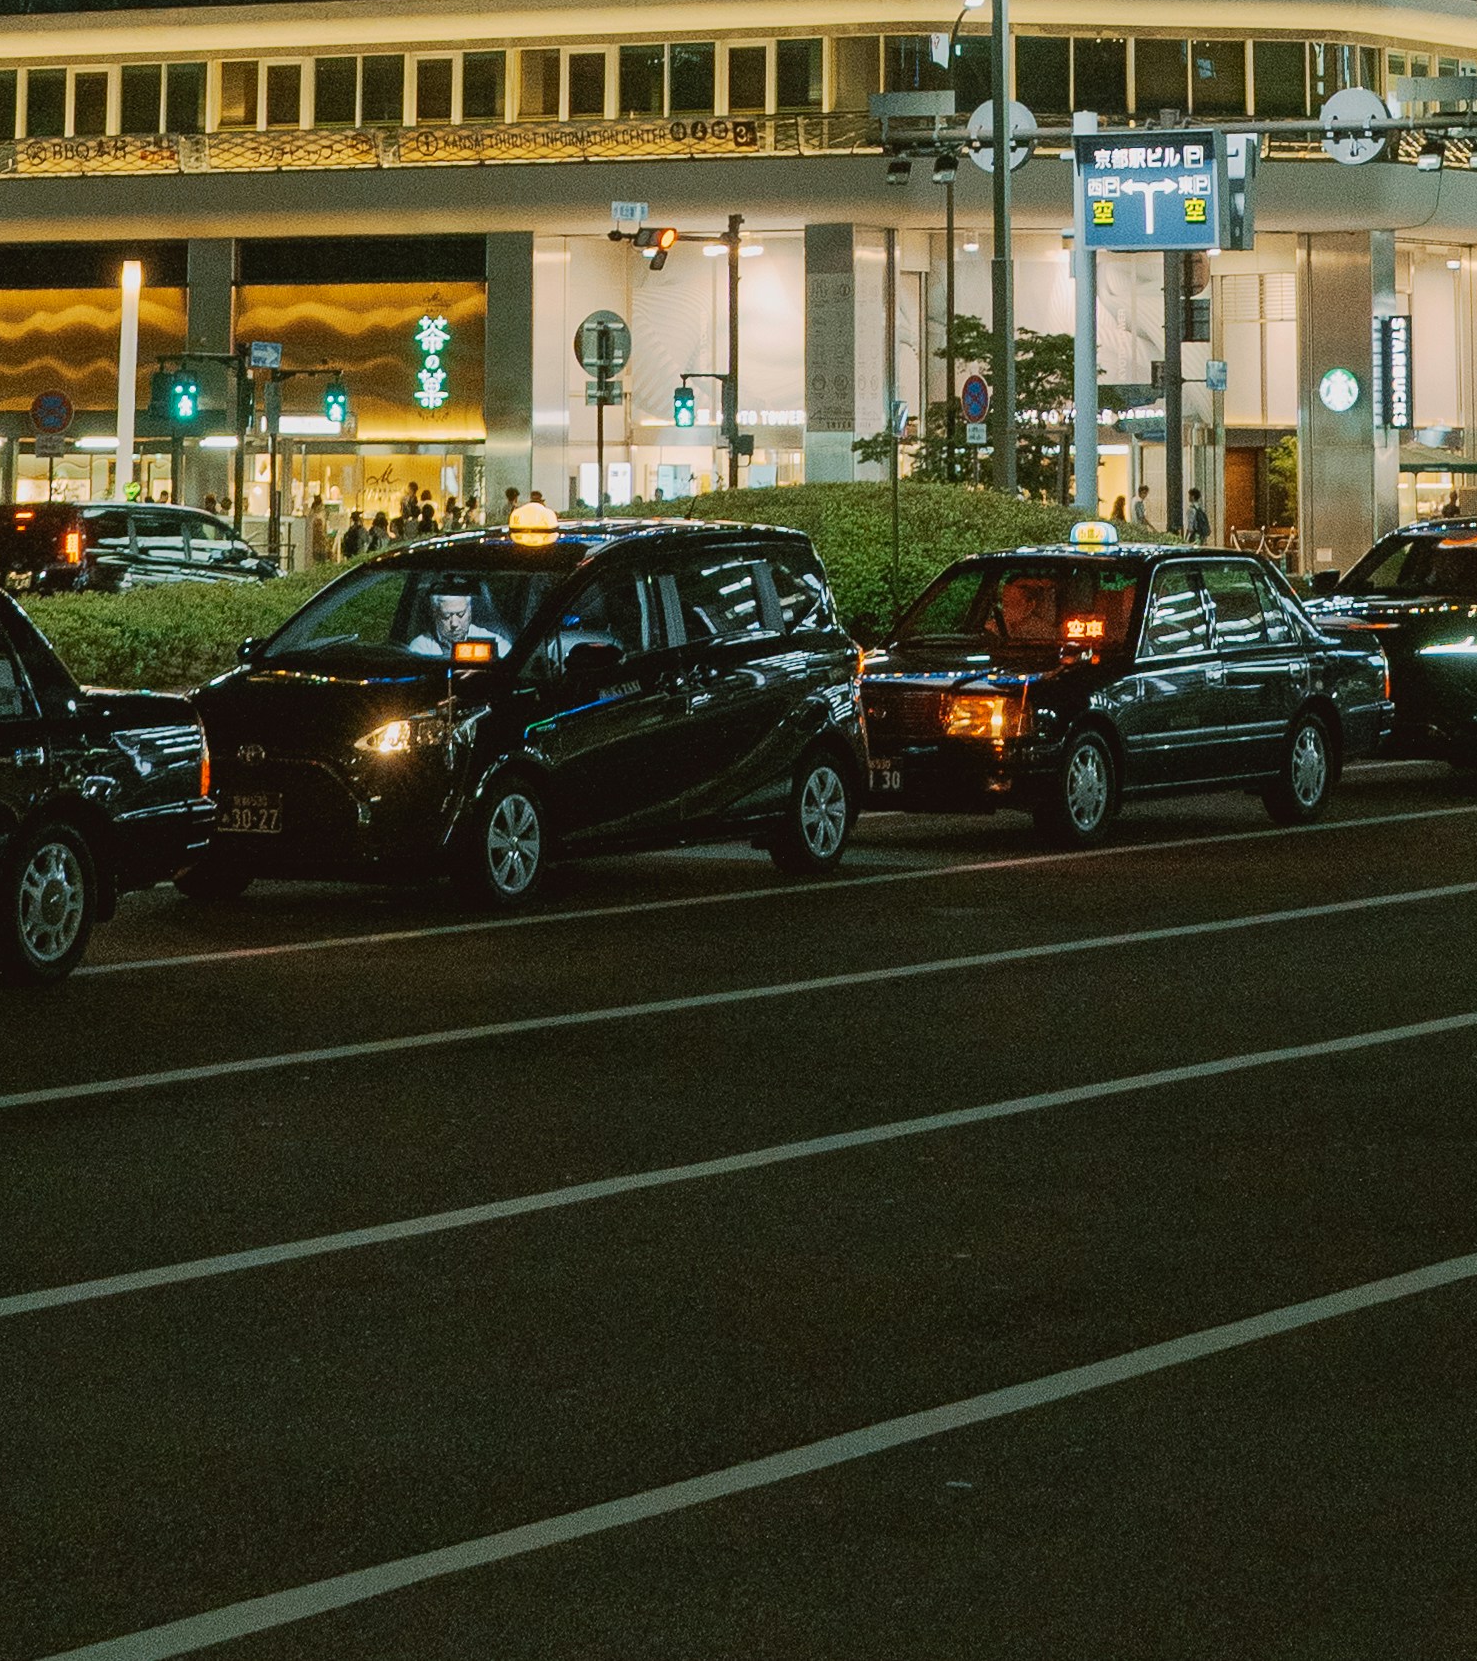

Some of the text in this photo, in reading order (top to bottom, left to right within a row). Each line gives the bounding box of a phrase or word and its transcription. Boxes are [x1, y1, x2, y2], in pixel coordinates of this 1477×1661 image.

[540, 128, 621, 147] INFORMATION
[622, 126, 666, 145] CENTER
[52, 142, 91, 161] BBQ
[1093, 147, 1181, 169] 京都駅ビル
[1092, 198, 1206, 224] 空 空
[414, 314, 450, 409] 茶の菓
[1391, 317, 1408, 427] STARBUCKS
[760, 409, 807, 426] TOWER
[1066, 619, 1104, 638] 空車
